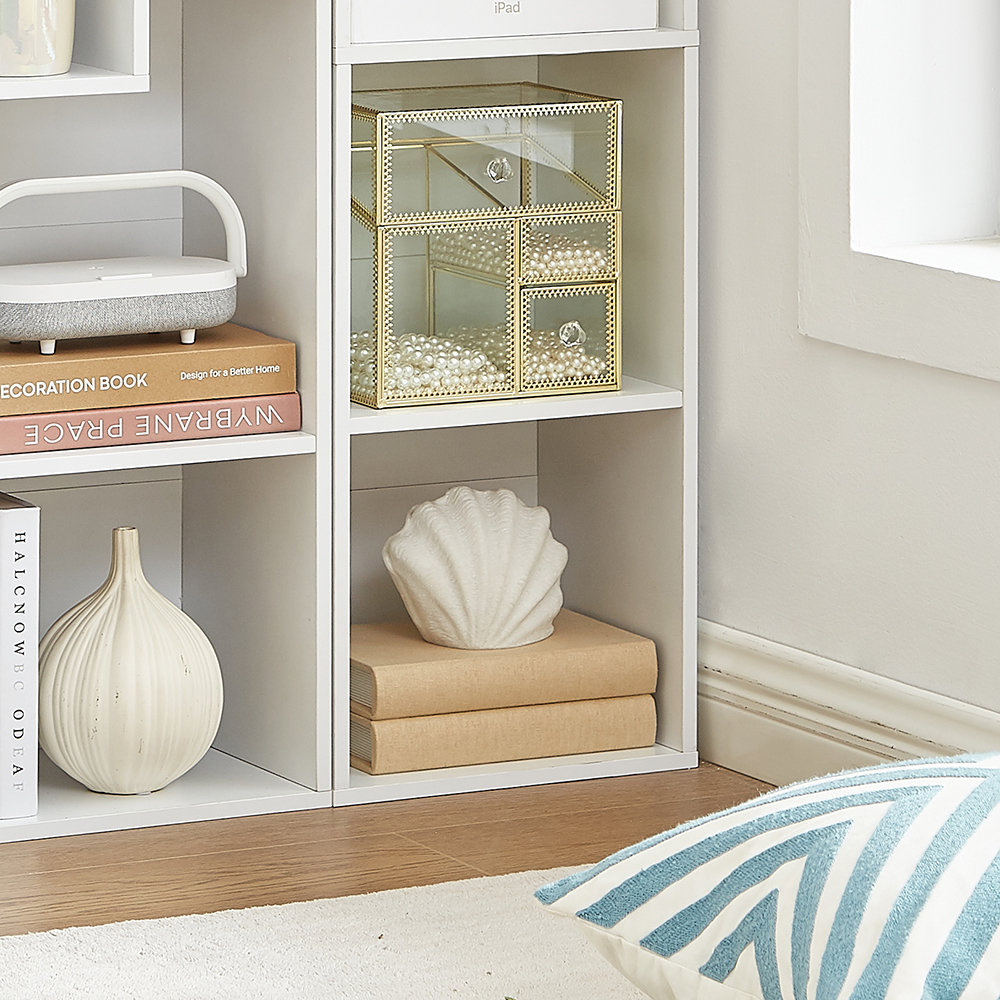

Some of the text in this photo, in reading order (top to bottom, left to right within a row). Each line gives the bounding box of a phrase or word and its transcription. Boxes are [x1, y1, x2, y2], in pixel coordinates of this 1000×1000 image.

[494, 0, 521, 14] iPad
[100, 373, 147, 390] BOOK
[180, 370, 209, 382] Design
[209, 368, 222, 378] for
[229, 366, 254, 377] Better
[255, 364, 280, 374] Home
[24, 404, 284, 446] WYBRANE PRACE
